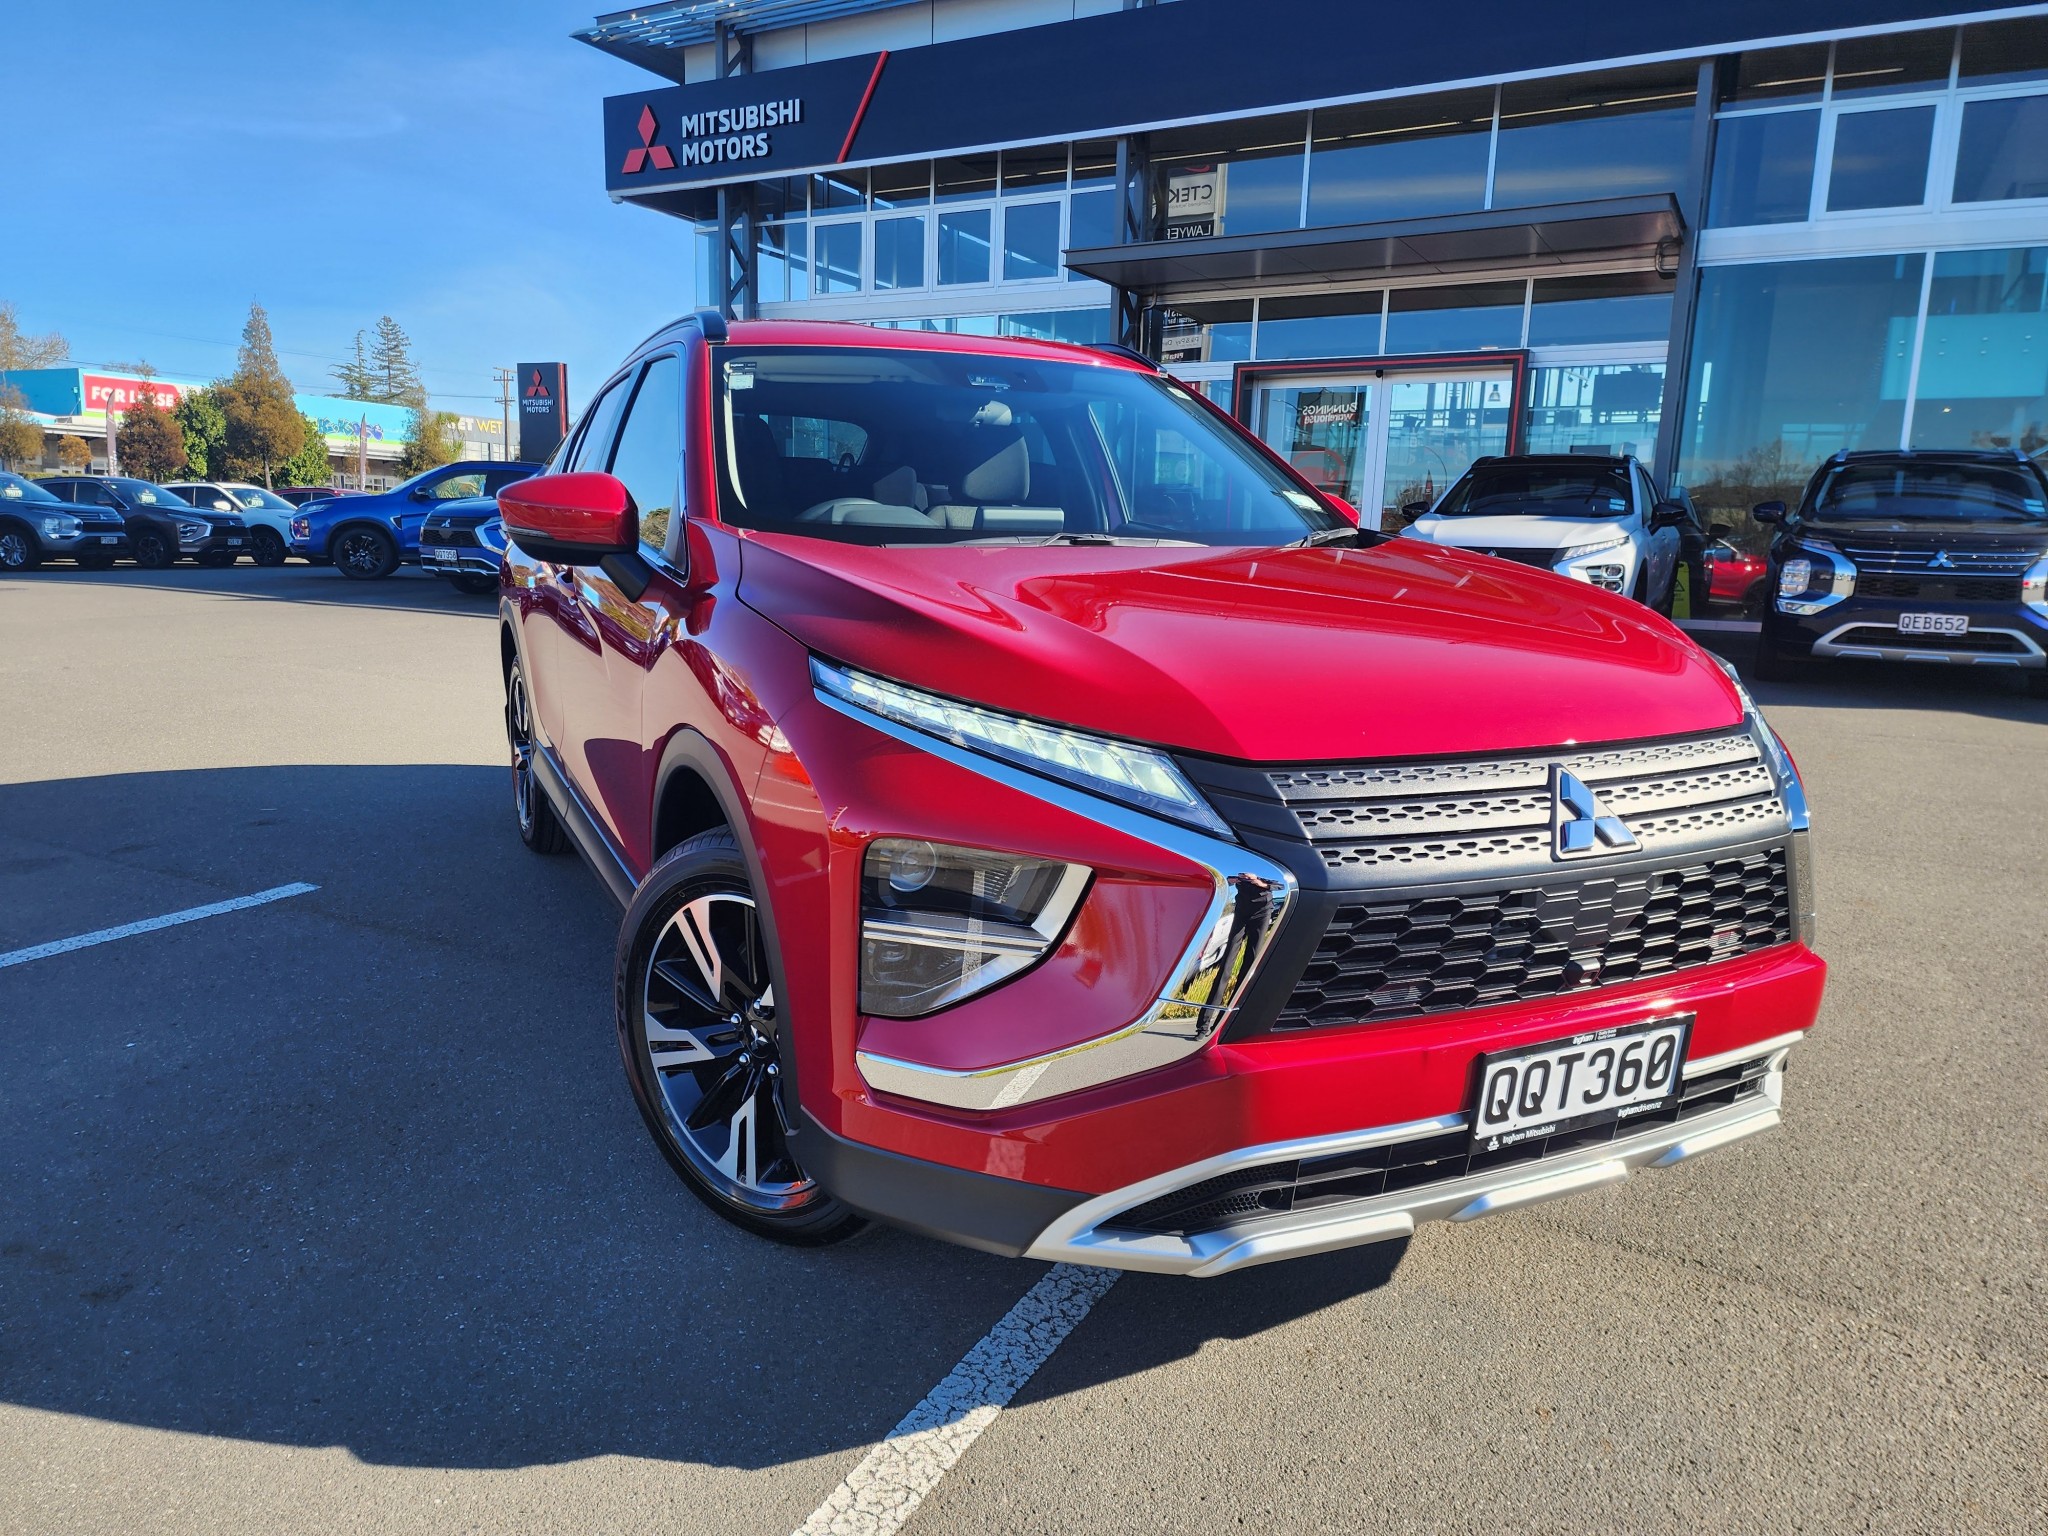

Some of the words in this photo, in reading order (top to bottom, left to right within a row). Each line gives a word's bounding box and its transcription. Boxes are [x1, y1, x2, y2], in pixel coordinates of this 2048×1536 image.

[681, 98, 801, 138] MITSUBISHI
[682, 132, 769, 166] MOTORS
[91, 386, 126, 403] FOR
[526, 406, 550, 414] MOTORS
[475, 418, 503, 435] WET
[1901, 615, 1966, 632] QEB652
[1485, 1034, 1676, 1125] QQT360
[1502, 1132, 1525, 1144] Ingham
[1525, 1124, 1556, 1138] Mitsubishi
